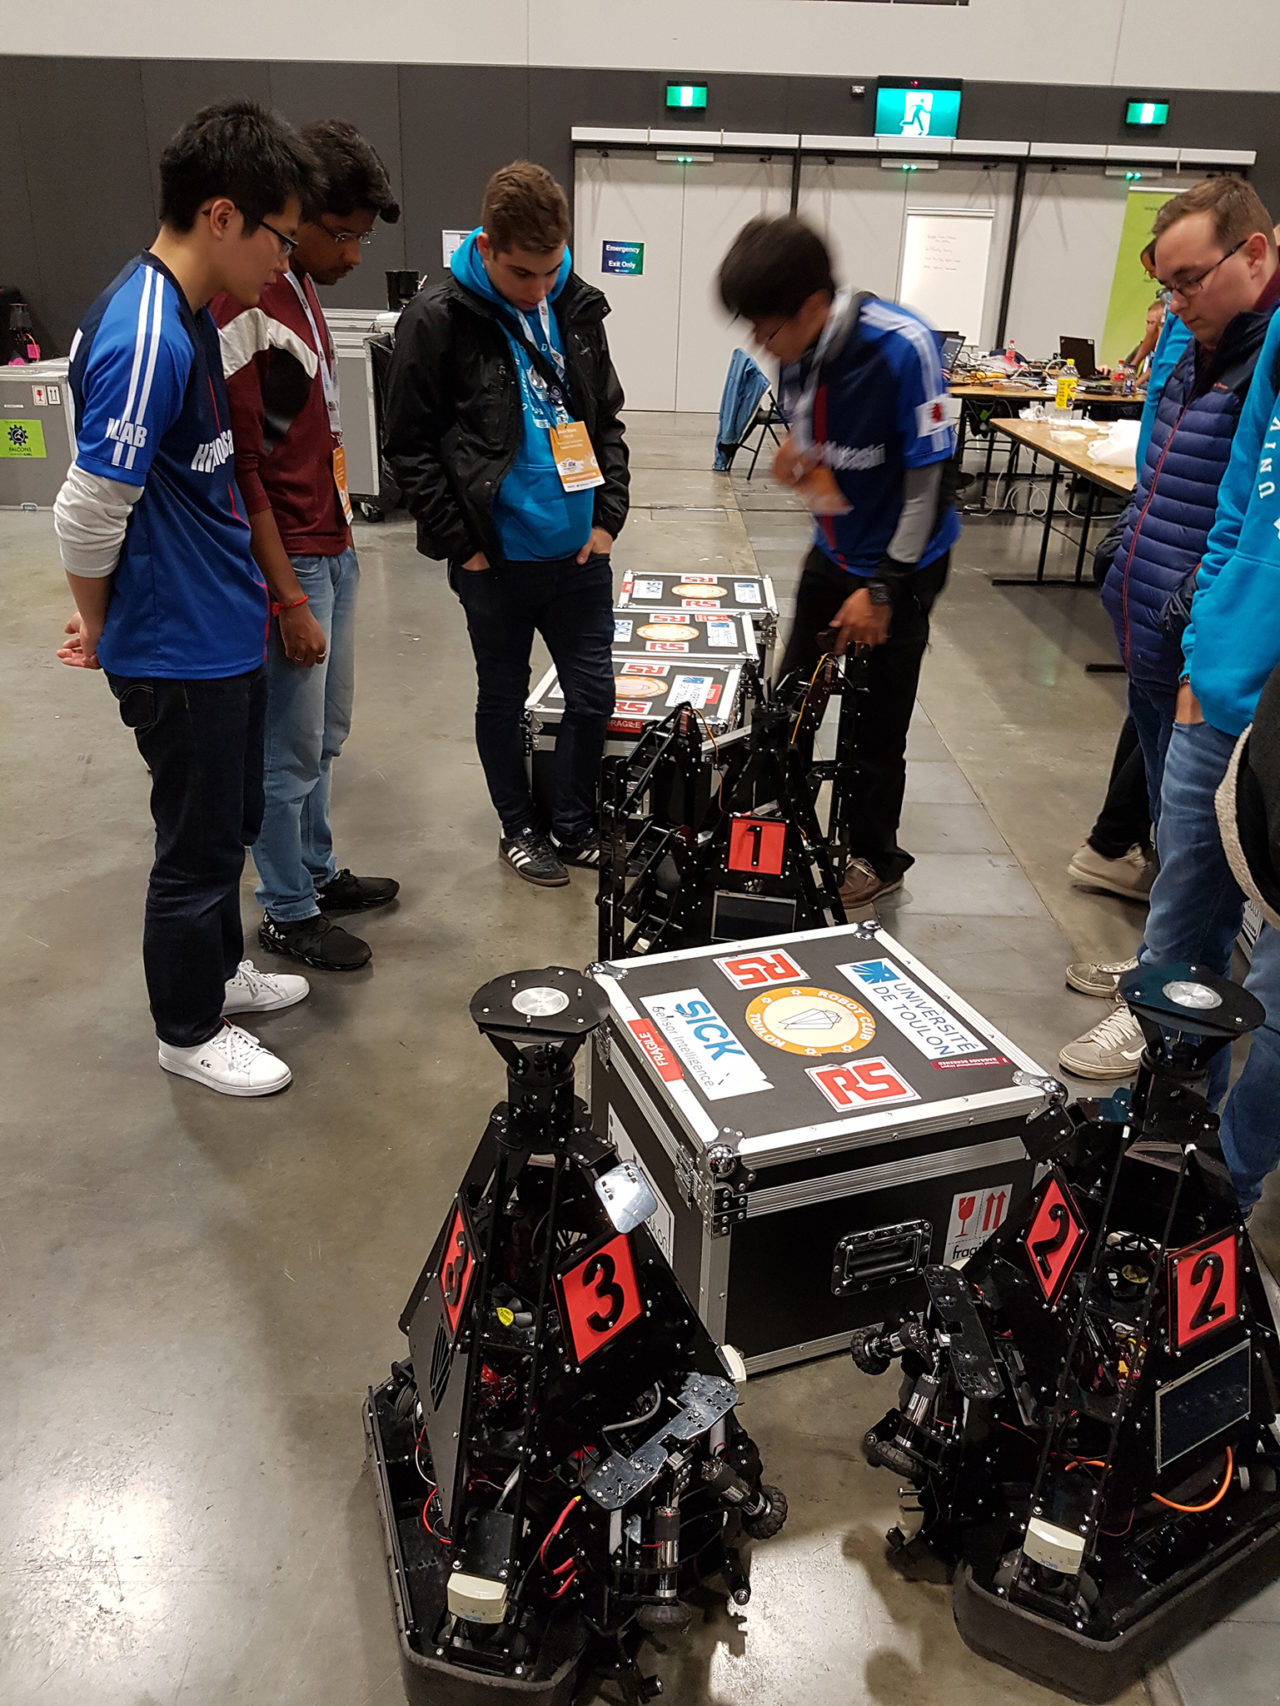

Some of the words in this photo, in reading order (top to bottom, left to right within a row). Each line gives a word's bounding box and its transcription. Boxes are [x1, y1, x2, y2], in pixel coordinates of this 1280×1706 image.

[606, 244, 640, 254] Emergency
[621, 261, 636, 269] Only
[653, 615, 686, 623] RS
[685, 600, 717, 608] RS
[649, 642, 686, 651] RS
[626, 664, 665, 675] RS
[610, 719, 641, 729] RAGILE
[746, 825, 763, 867] 1
[724, 953, 801, 985] RS
[674, 1000, 746, 1061] SICK
[749, 1013, 786, 1048] TOULON
[817, 990, 864, 1015] ROBOT
[859, 1016, 874, 1041] CLUB
[873, 986, 899, 1003] DE
[893, 1003, 956, 1057] TOULON
[893, 982, 980, 1052] UNIVERSITÉ
[638, 1031, 669, 1067] FRAGILE
[815, 1061, 908, 1106] RS
[1031, 1203, 1071, 1280] 2
[581, 1252, 625, 1333] 3
[1188, 1251, 1226, 1331] 2
